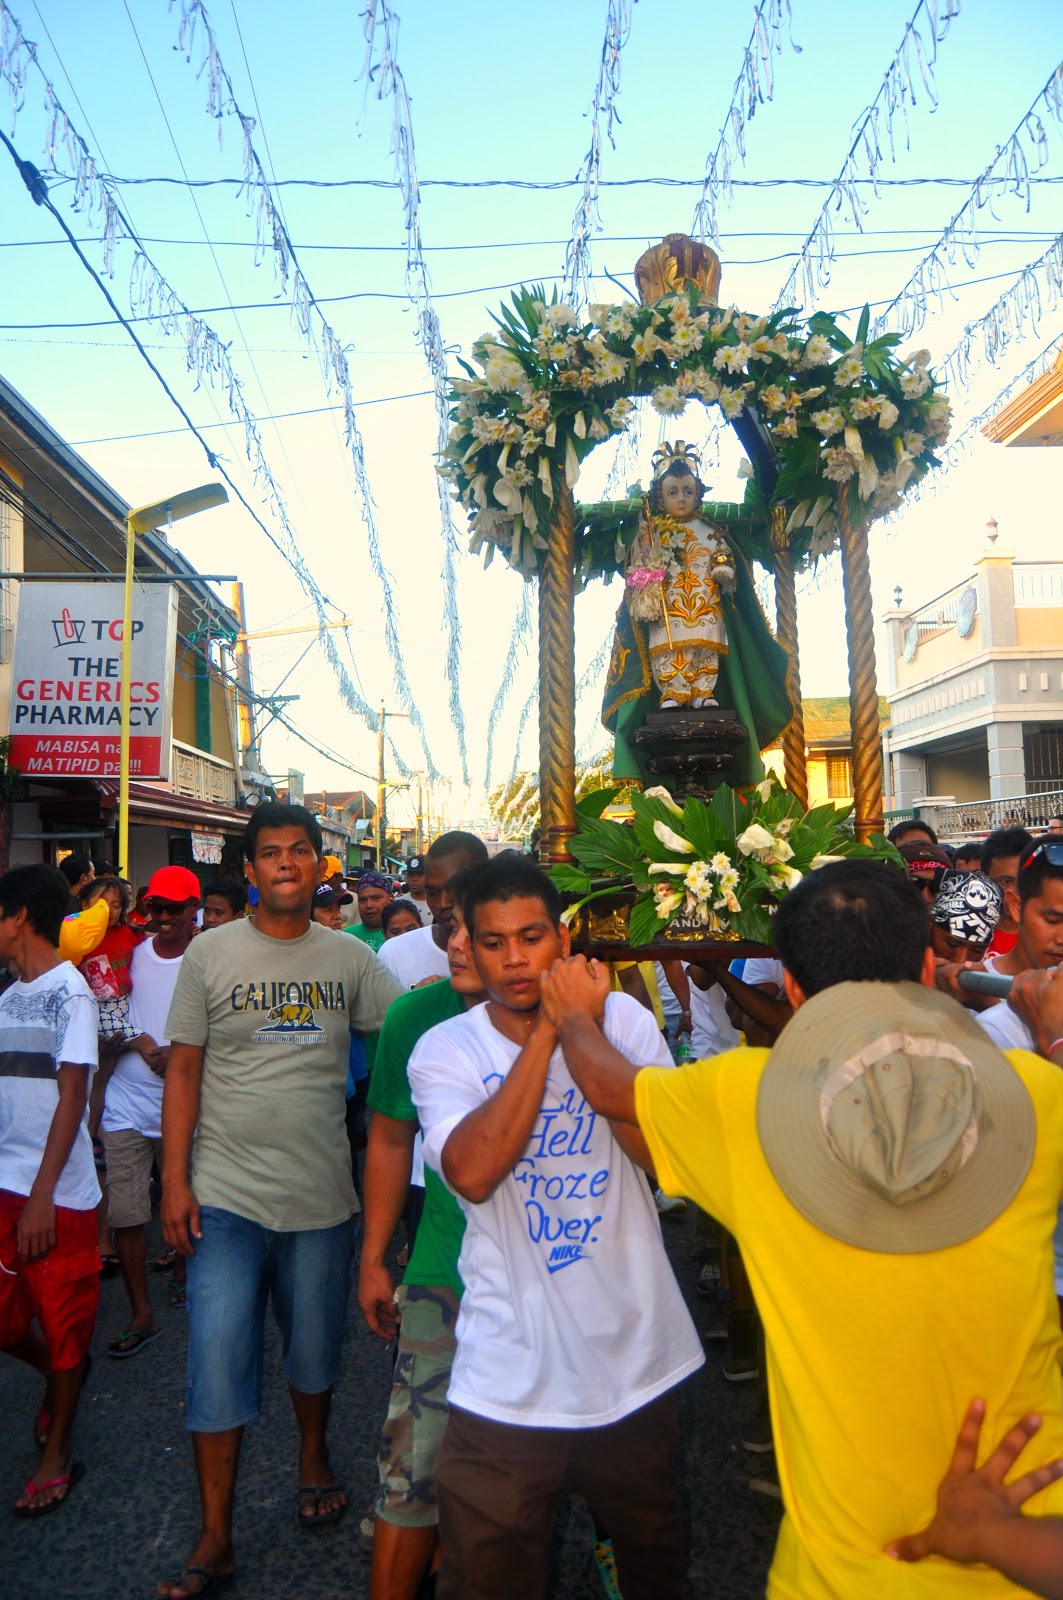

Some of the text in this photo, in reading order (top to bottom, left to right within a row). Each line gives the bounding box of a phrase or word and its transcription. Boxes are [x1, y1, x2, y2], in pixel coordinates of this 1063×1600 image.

[92, 619, 144, 641] TGP
[68, 657, 119, 678] THE
[16, 679, 160, 703] GENERICS
[15, 704, 159, 727] PHARMACY
[35, 740, 122, 754] MABISA na
[27, 757, 100, 772] MATIPID
[669, 918, 701, 928] AND
[231, 981, 345, 1011] CALIFORNIA
[530, 1112, 596, 1158] Hell
[549, 1245, 583, 1262] NIKE
